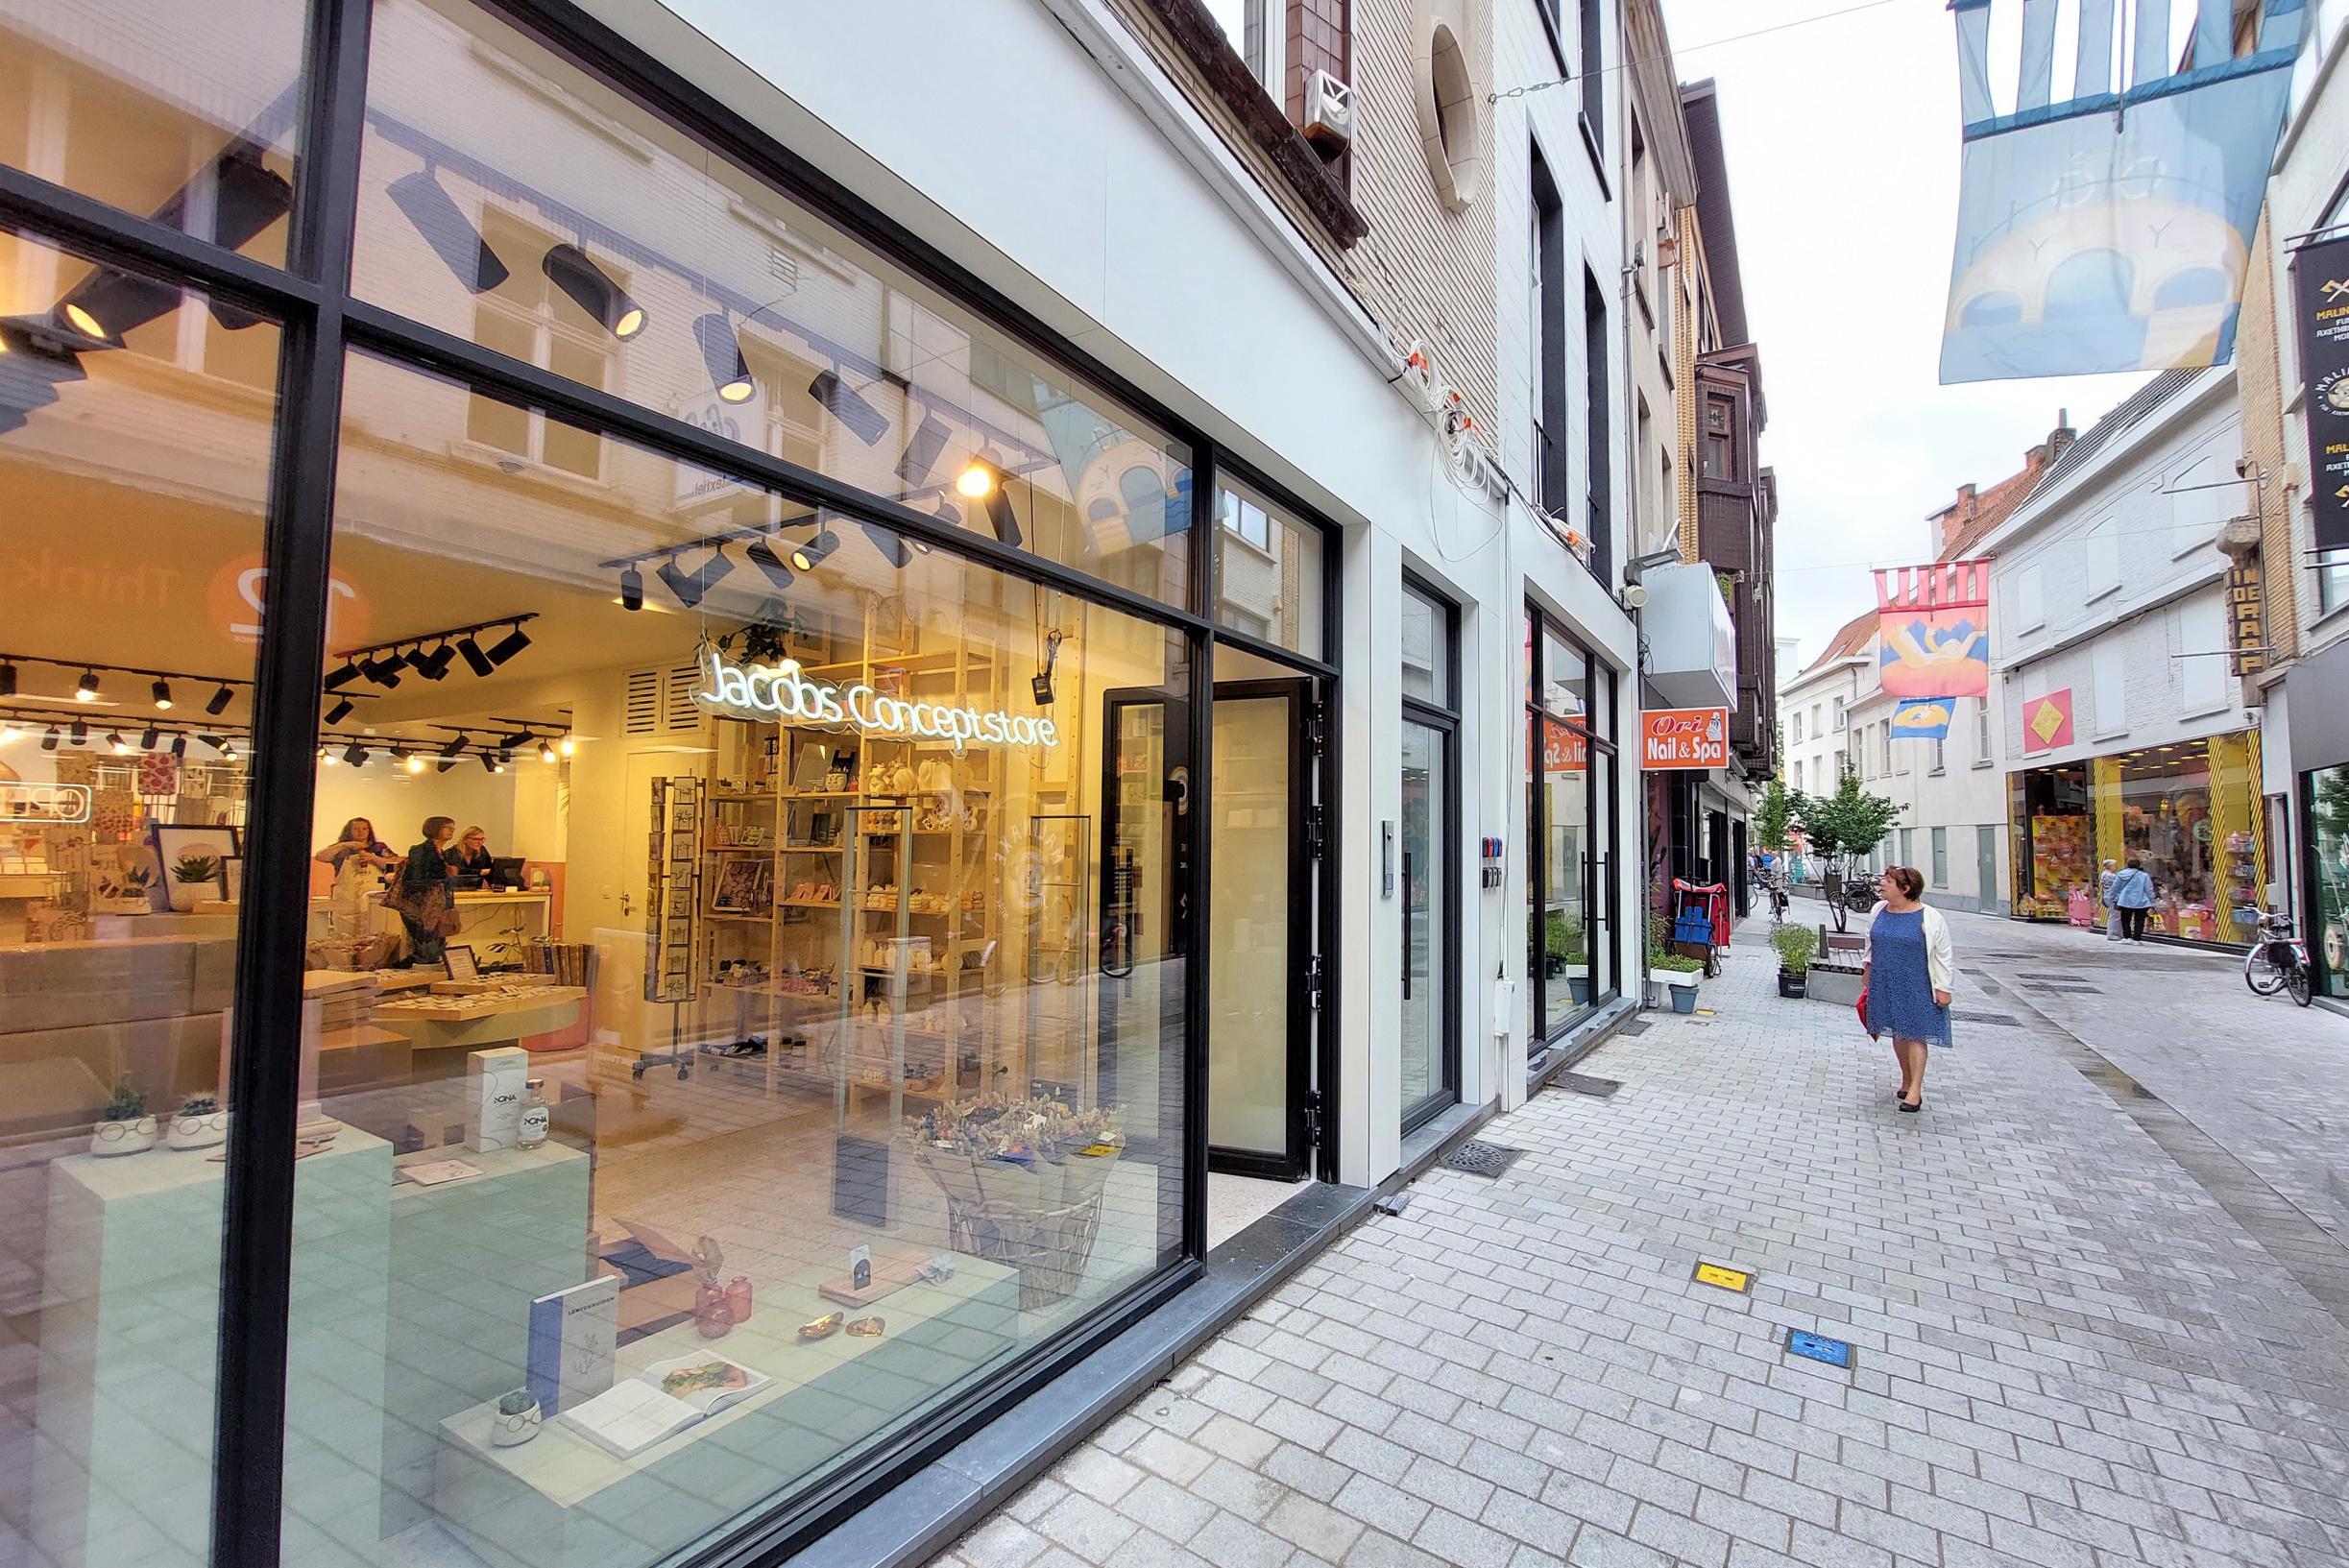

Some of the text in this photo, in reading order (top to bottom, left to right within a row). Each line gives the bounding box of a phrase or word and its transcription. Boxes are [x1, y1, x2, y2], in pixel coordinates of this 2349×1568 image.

[700, 653, 1059, 750] Jacobs Conceptstore
[1652, 715, 1705, 736] Ori
[1647, 736, 1721, 763] Nail & Spa
